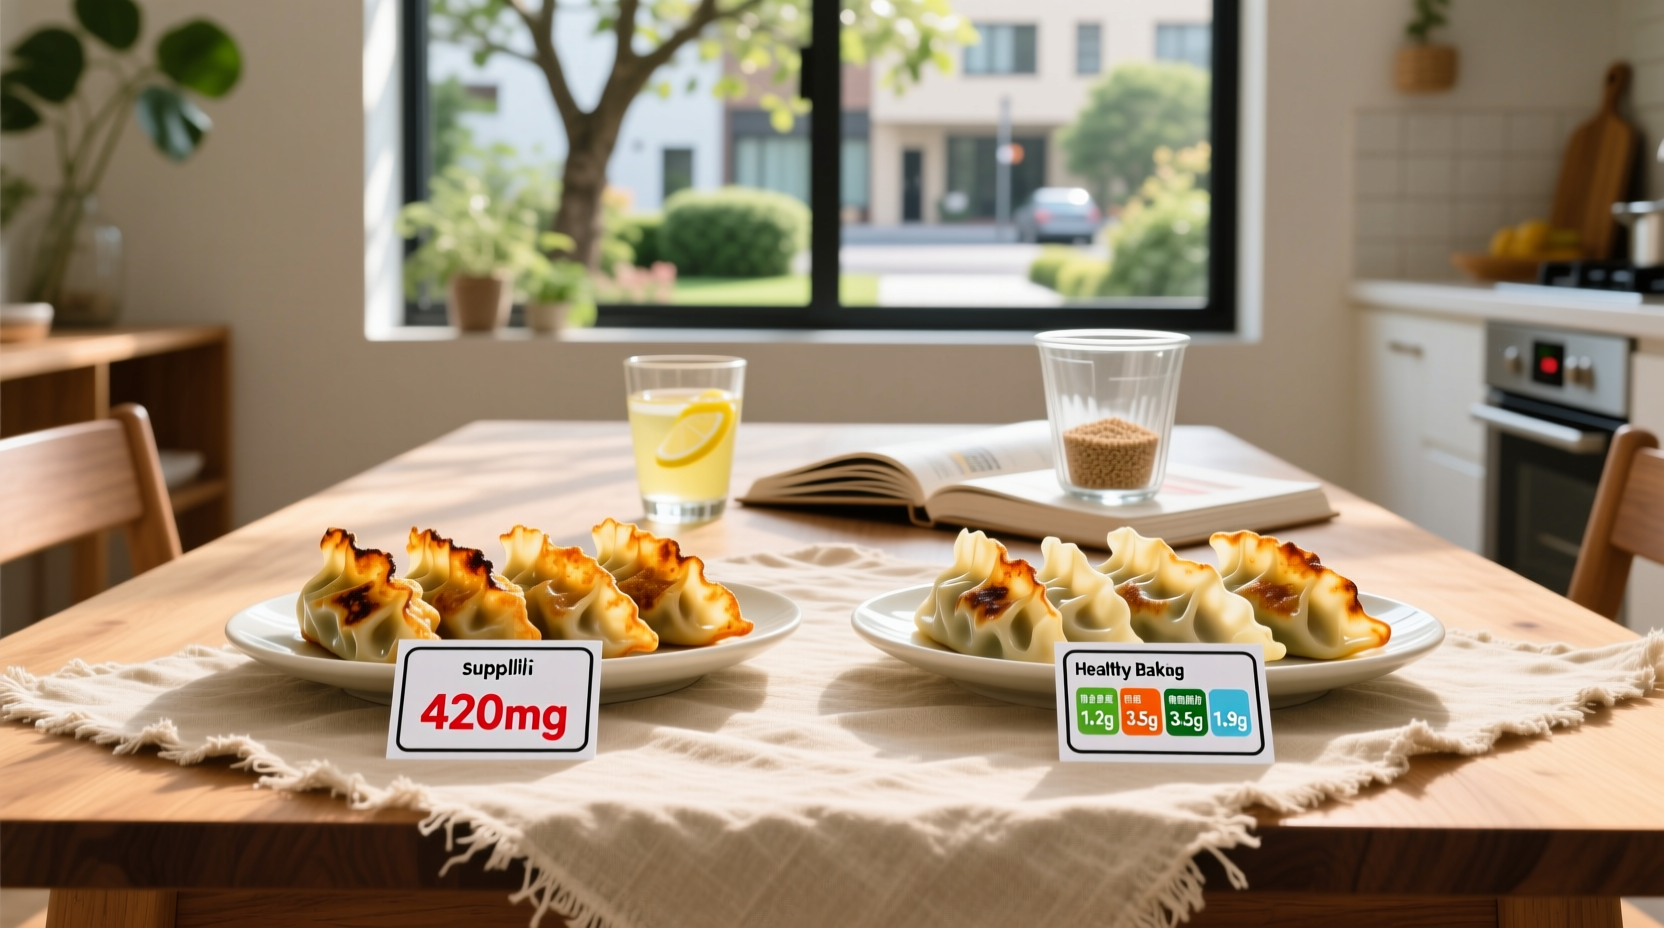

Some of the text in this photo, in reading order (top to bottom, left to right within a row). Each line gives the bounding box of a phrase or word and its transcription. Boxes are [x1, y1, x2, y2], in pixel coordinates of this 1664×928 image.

[420, 693, 568, 741] 420mg
[1081, 710, 1114, 731] 1.2g
[1170, 711, 1203, 732] 3.5g
[1213, 711, 1248, 732] 1.9g
